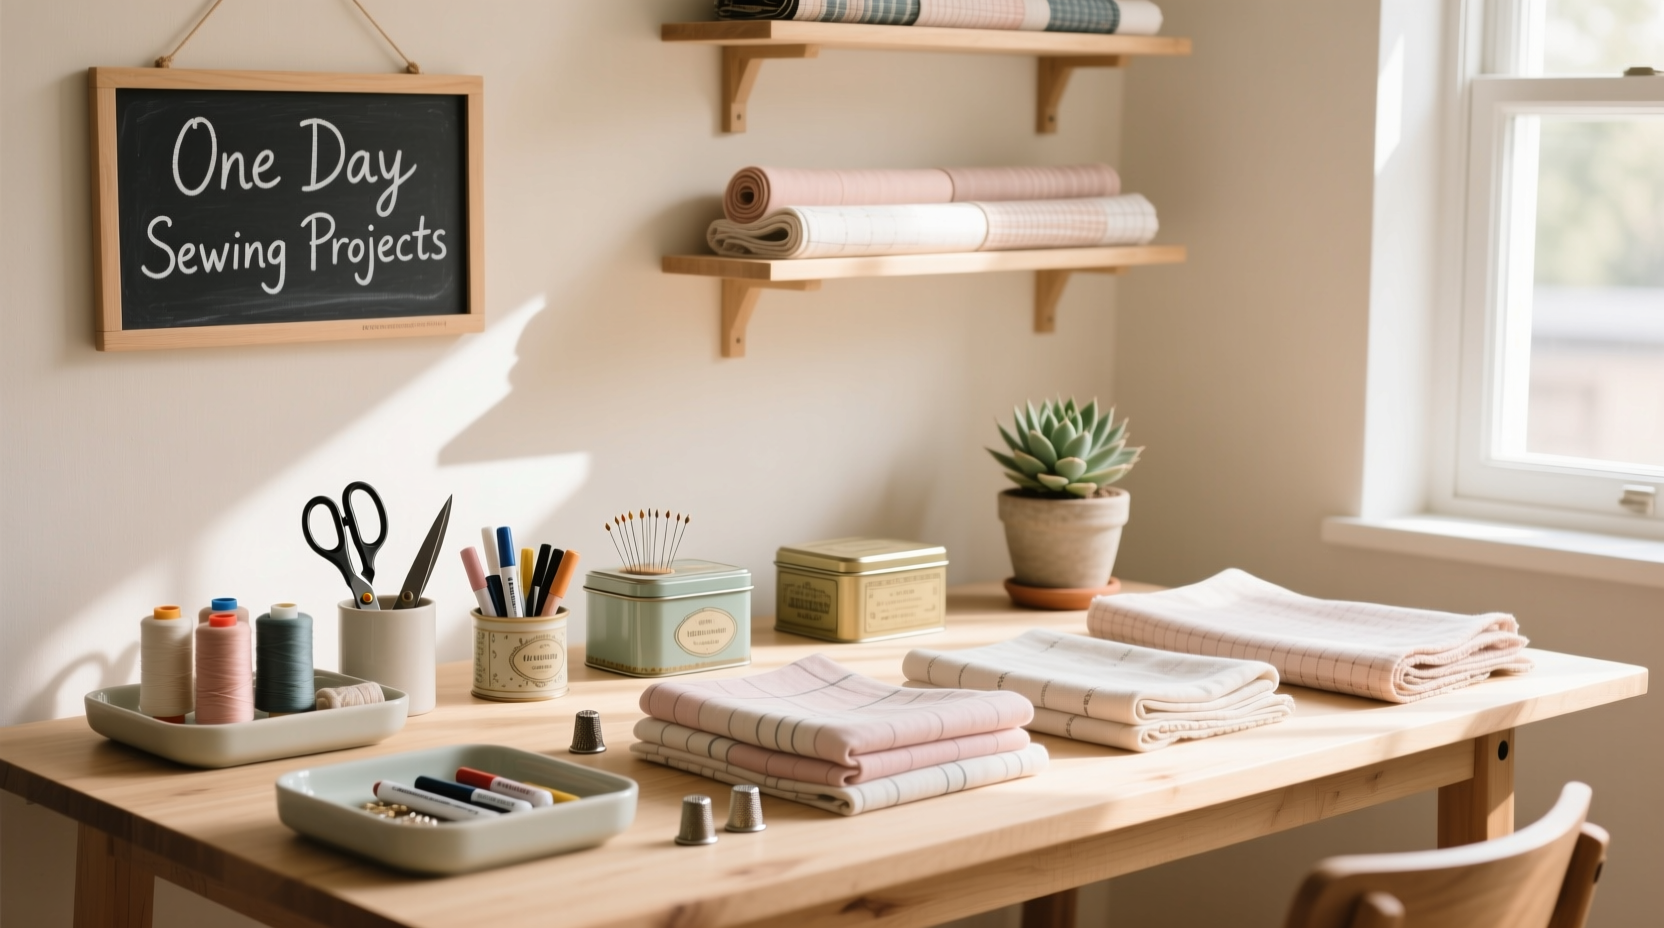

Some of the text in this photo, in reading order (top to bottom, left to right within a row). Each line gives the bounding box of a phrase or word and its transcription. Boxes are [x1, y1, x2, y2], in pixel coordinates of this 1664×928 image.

[172, 116, 417, 217] One Day
[141, 212, 447, 295] Sewing Projects
